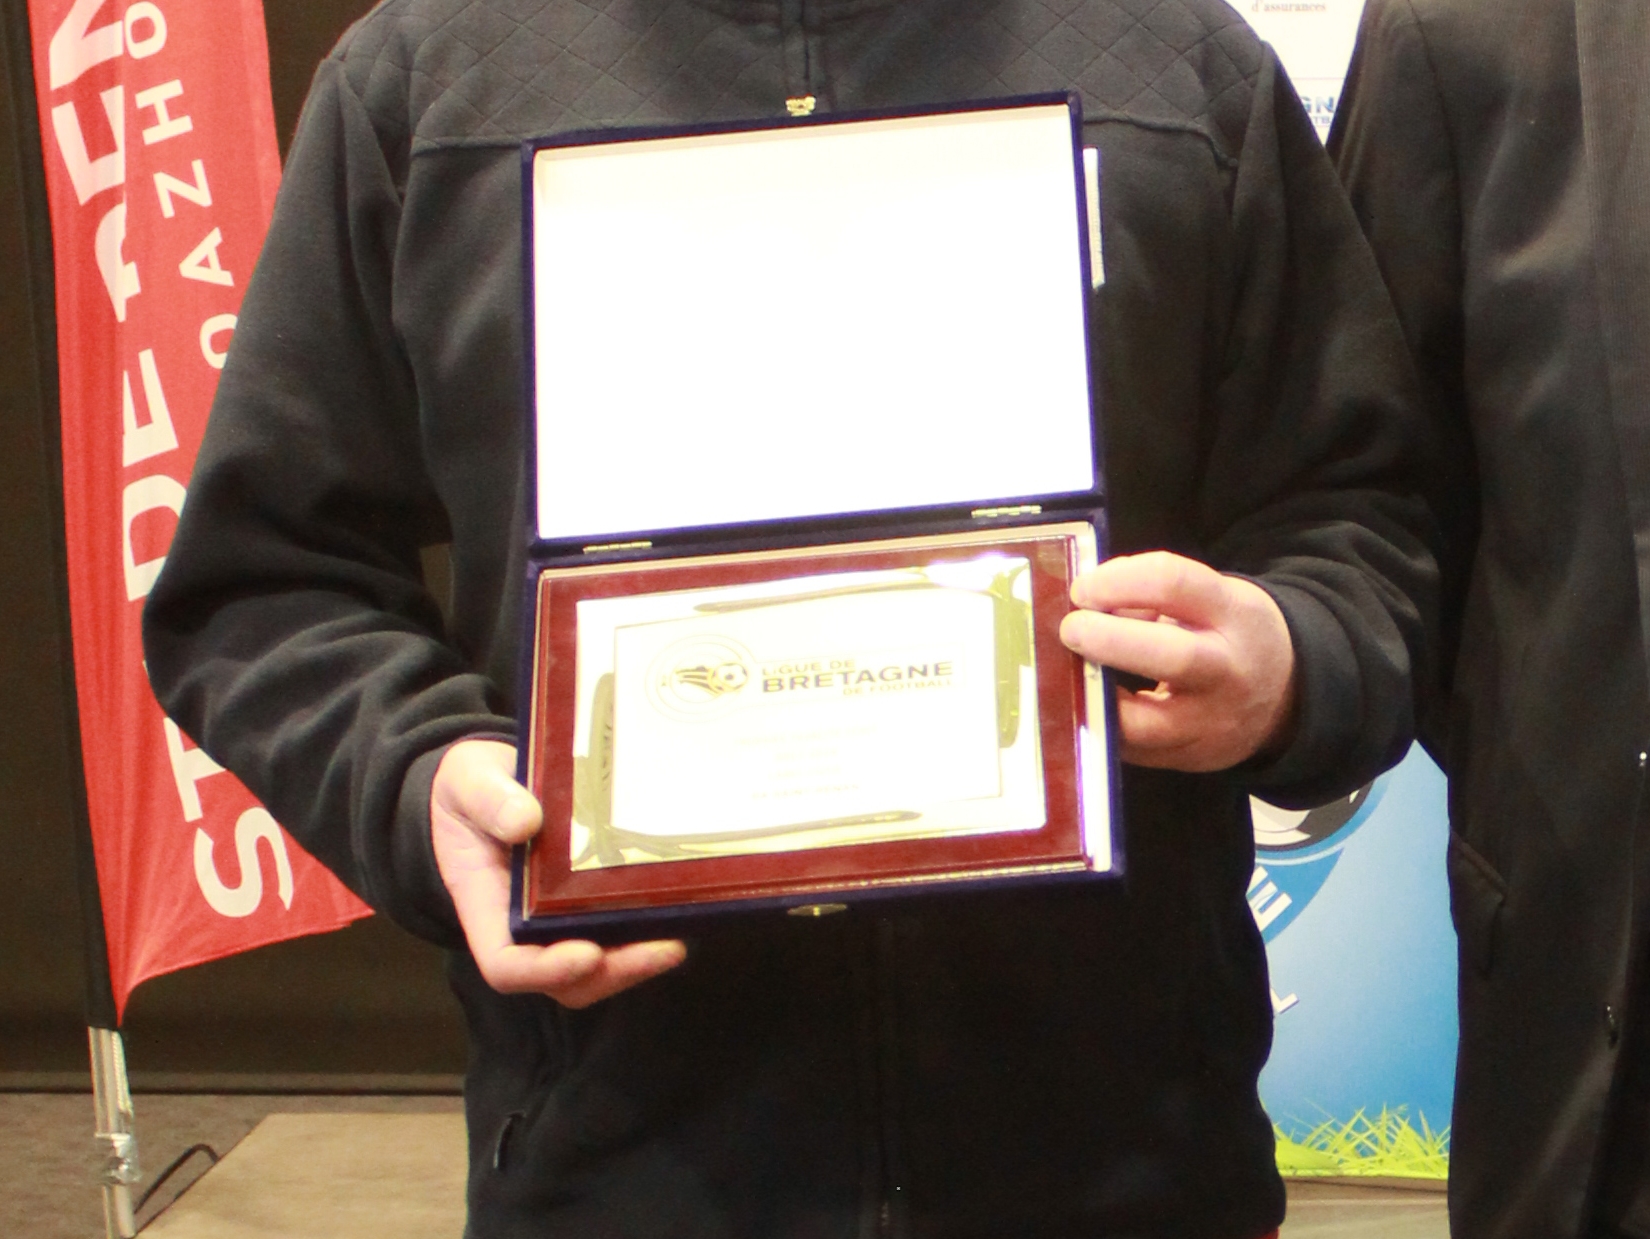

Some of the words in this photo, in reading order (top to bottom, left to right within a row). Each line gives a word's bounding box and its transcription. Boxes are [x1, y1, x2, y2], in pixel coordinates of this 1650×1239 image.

[828, 658, 856, 671] DE
[760, 660, 954, 695] BRETAGNE
[841, 685, 864, 697] DE
[867, 678, 955, 696] FOOTBALL
